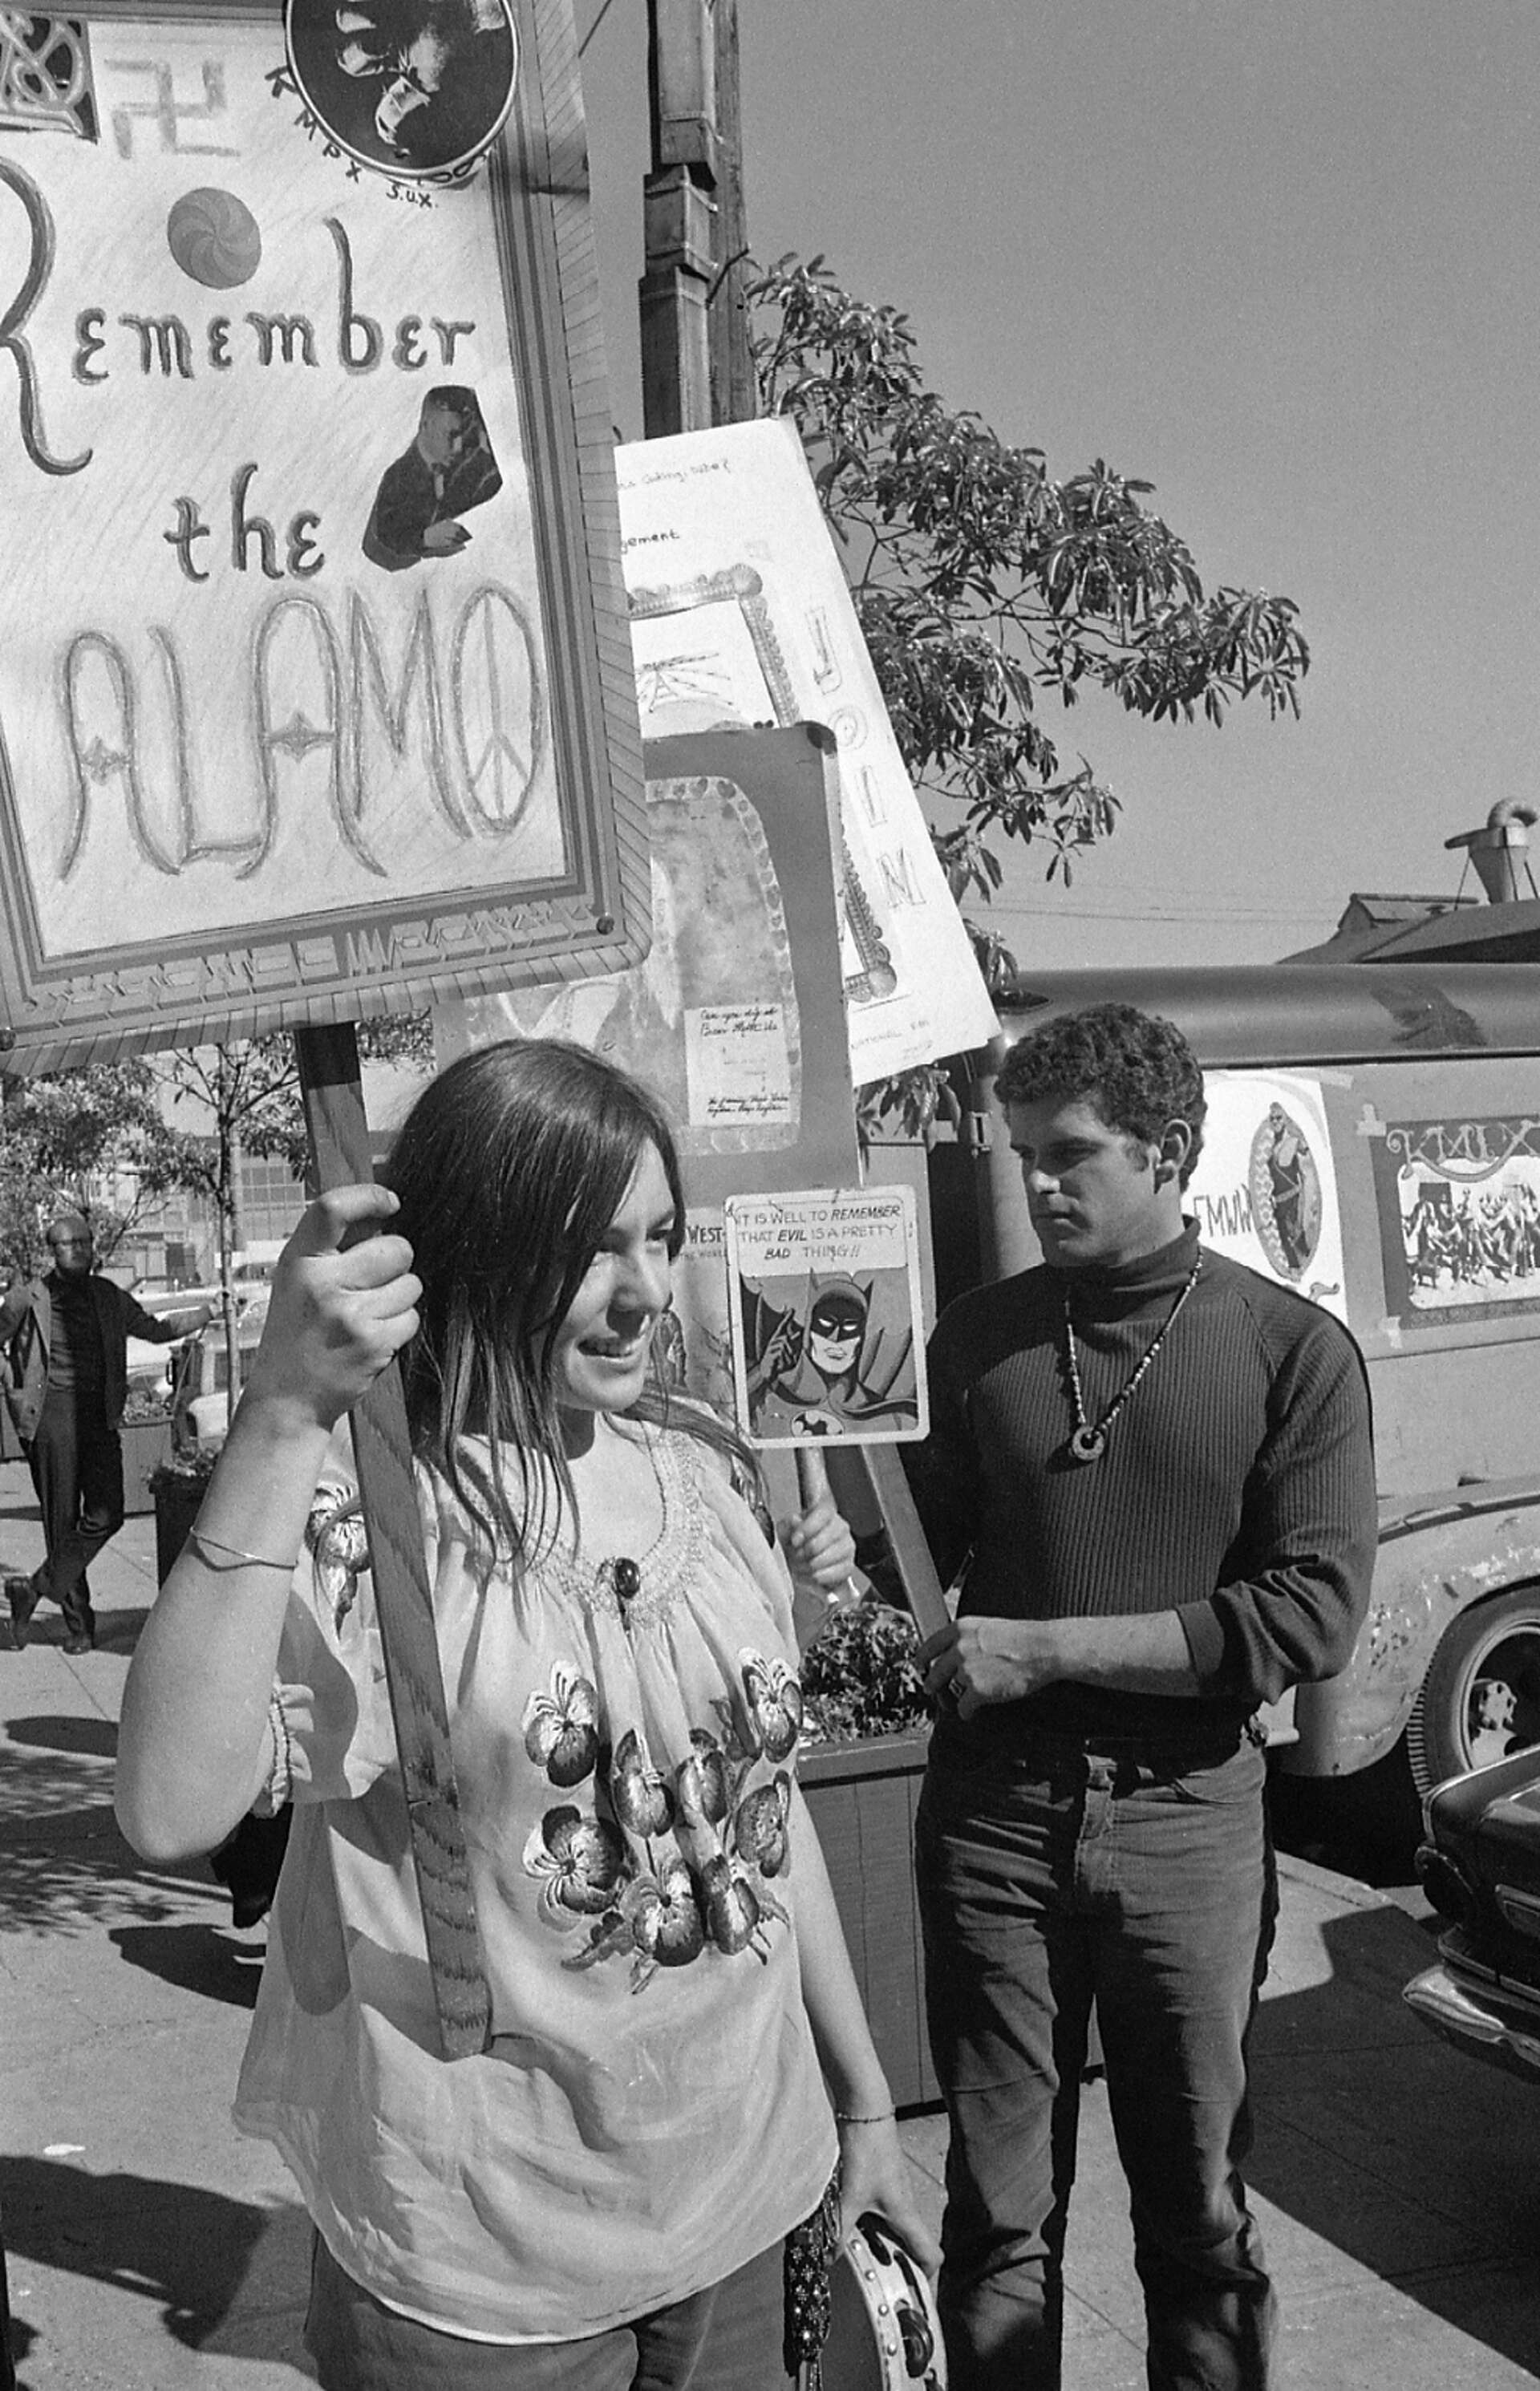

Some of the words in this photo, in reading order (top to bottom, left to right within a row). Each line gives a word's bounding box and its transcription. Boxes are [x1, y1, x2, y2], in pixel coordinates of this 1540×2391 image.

[163, 461, 326, 583] the
[55, 584, 544, 882] ALAMO
[755, 1211, 768, 1224] IS
[770, 1209, 807, 1224] WELL
[810, 1210, 829, 1222] TO
[830, 1205, 902, 1221] REMEMBER
[739, 1230, 773, 1243] THAT
[777, 1227, 808, 1242] EVIL
[827, 1226, 840, 1240] A
[841, 1223, 898, 1240] PRETTY
[764, 1246, 792, 1261] BAD
